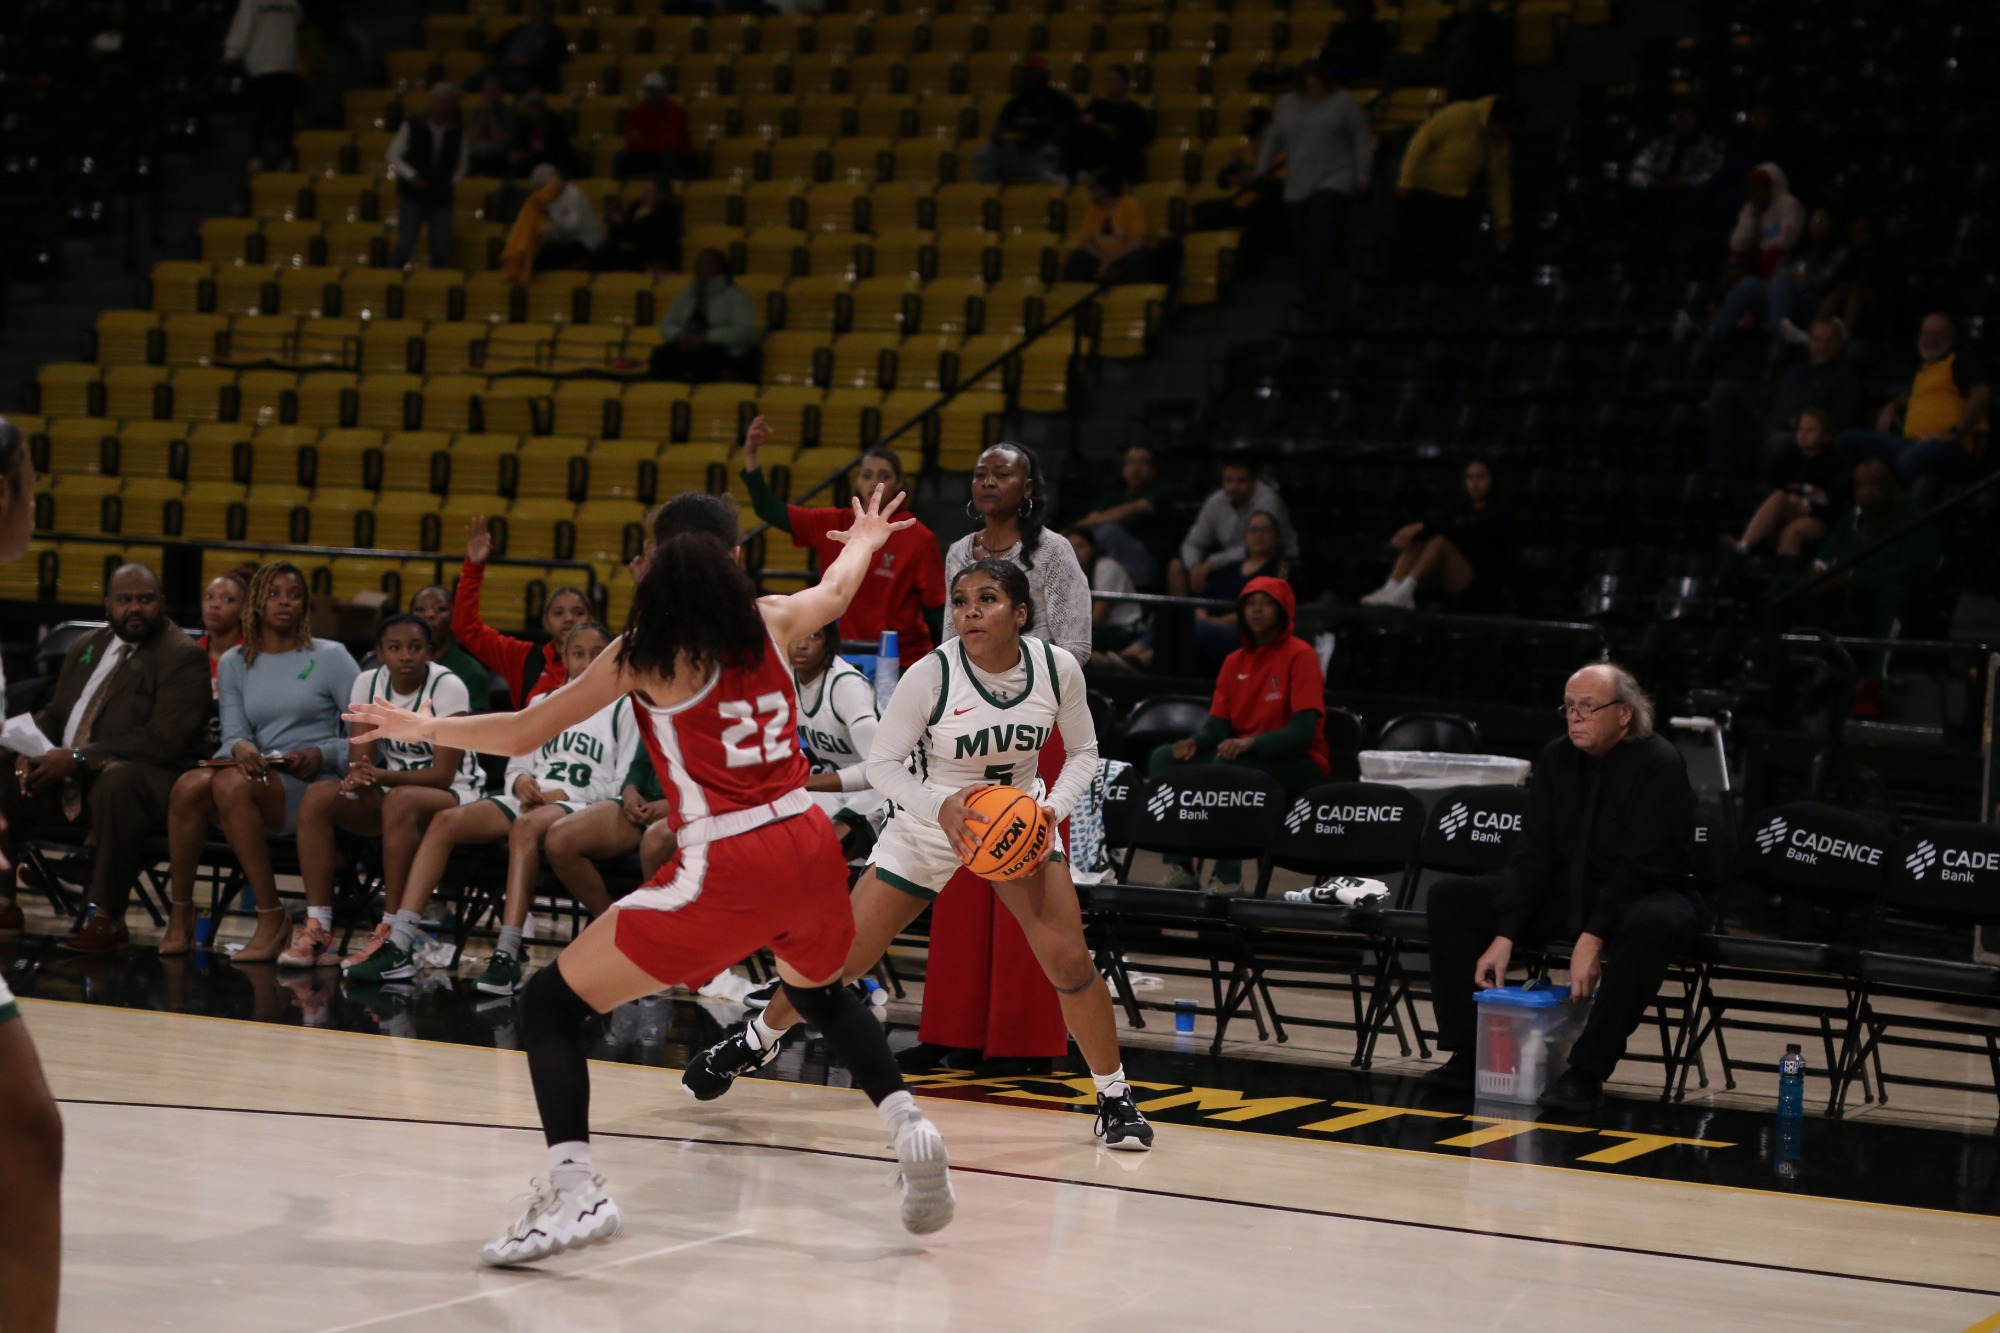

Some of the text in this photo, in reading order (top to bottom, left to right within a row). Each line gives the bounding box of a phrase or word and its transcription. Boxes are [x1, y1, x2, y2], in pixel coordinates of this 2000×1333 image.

[718, 690, 793, 768] 22
[541, 731, 604, 764] MVSU
[953, 723, 1051, 759] MVSU
[544, 761, 592, 788] 20
[1179, 790, 1267, 807] CADENCE
[1179, 809, 1209, 820] Bank
[1316, 805, 1404, 822] CADENCE
[1473, 811, 1522, 831] CADE
[989, 816, 1027, 860] NCAA
[1315, 823, 1346, 835] Bank
[1470, 830, 1502, 843] Bank
[1786, 847, 1818, 865] Bank
[1791, 829, 1883, 866] CADENCE
[1942, 849, 2000, 870] CADE
[1941, 869, 1975, 883] Bank
